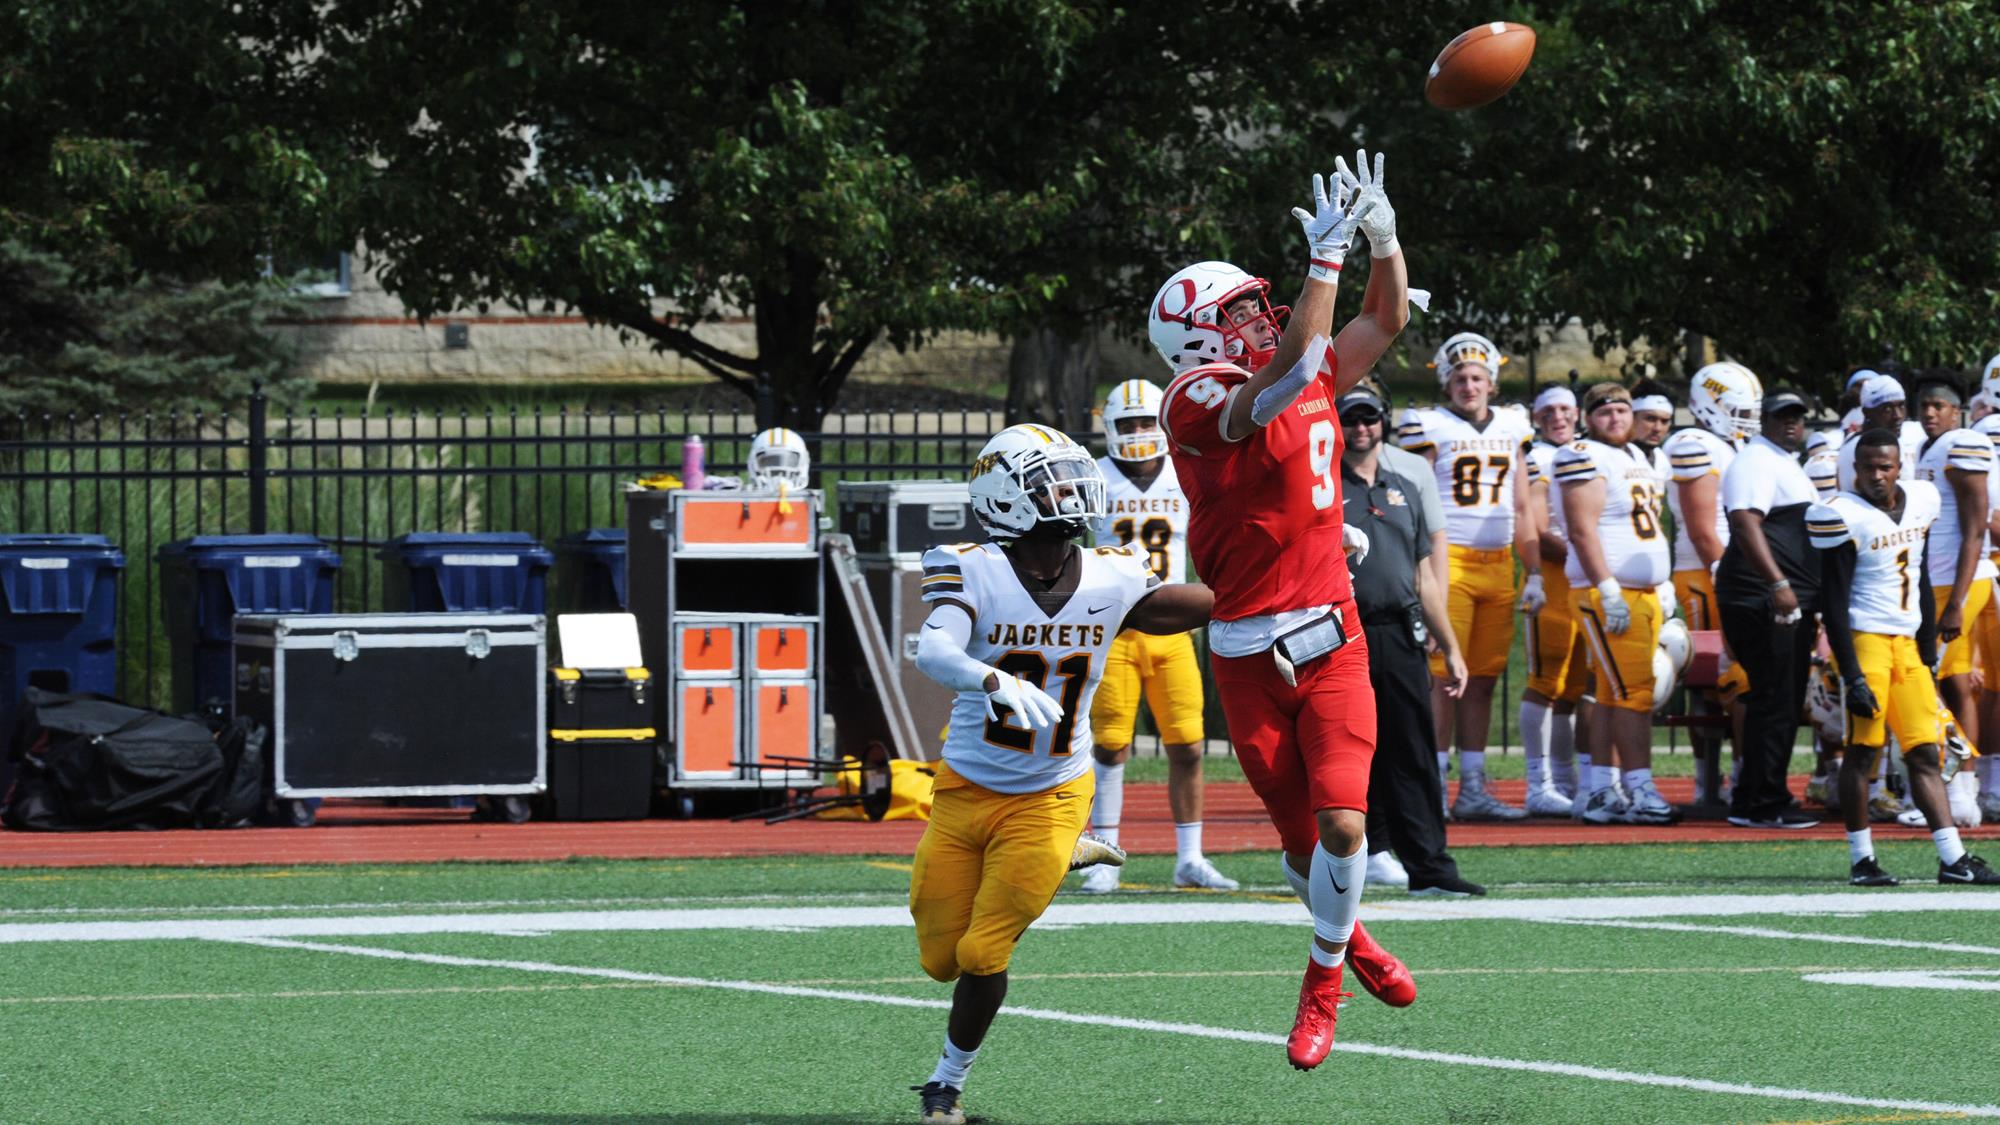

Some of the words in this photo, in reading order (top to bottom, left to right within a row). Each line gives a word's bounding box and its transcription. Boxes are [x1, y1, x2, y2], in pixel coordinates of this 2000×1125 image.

[1451, 440, 1512, 452] JACKETS
[1309, 419, 1336, 511] 9
[1452, 453, 1511, 507] 87
[1106, 499, 1180, 514] JACKETS
[1871, 527, 1927, 550] JACKETS
[987, 623, 1105, 648] JACKETS
[983, 650, 1092, 757] 21
